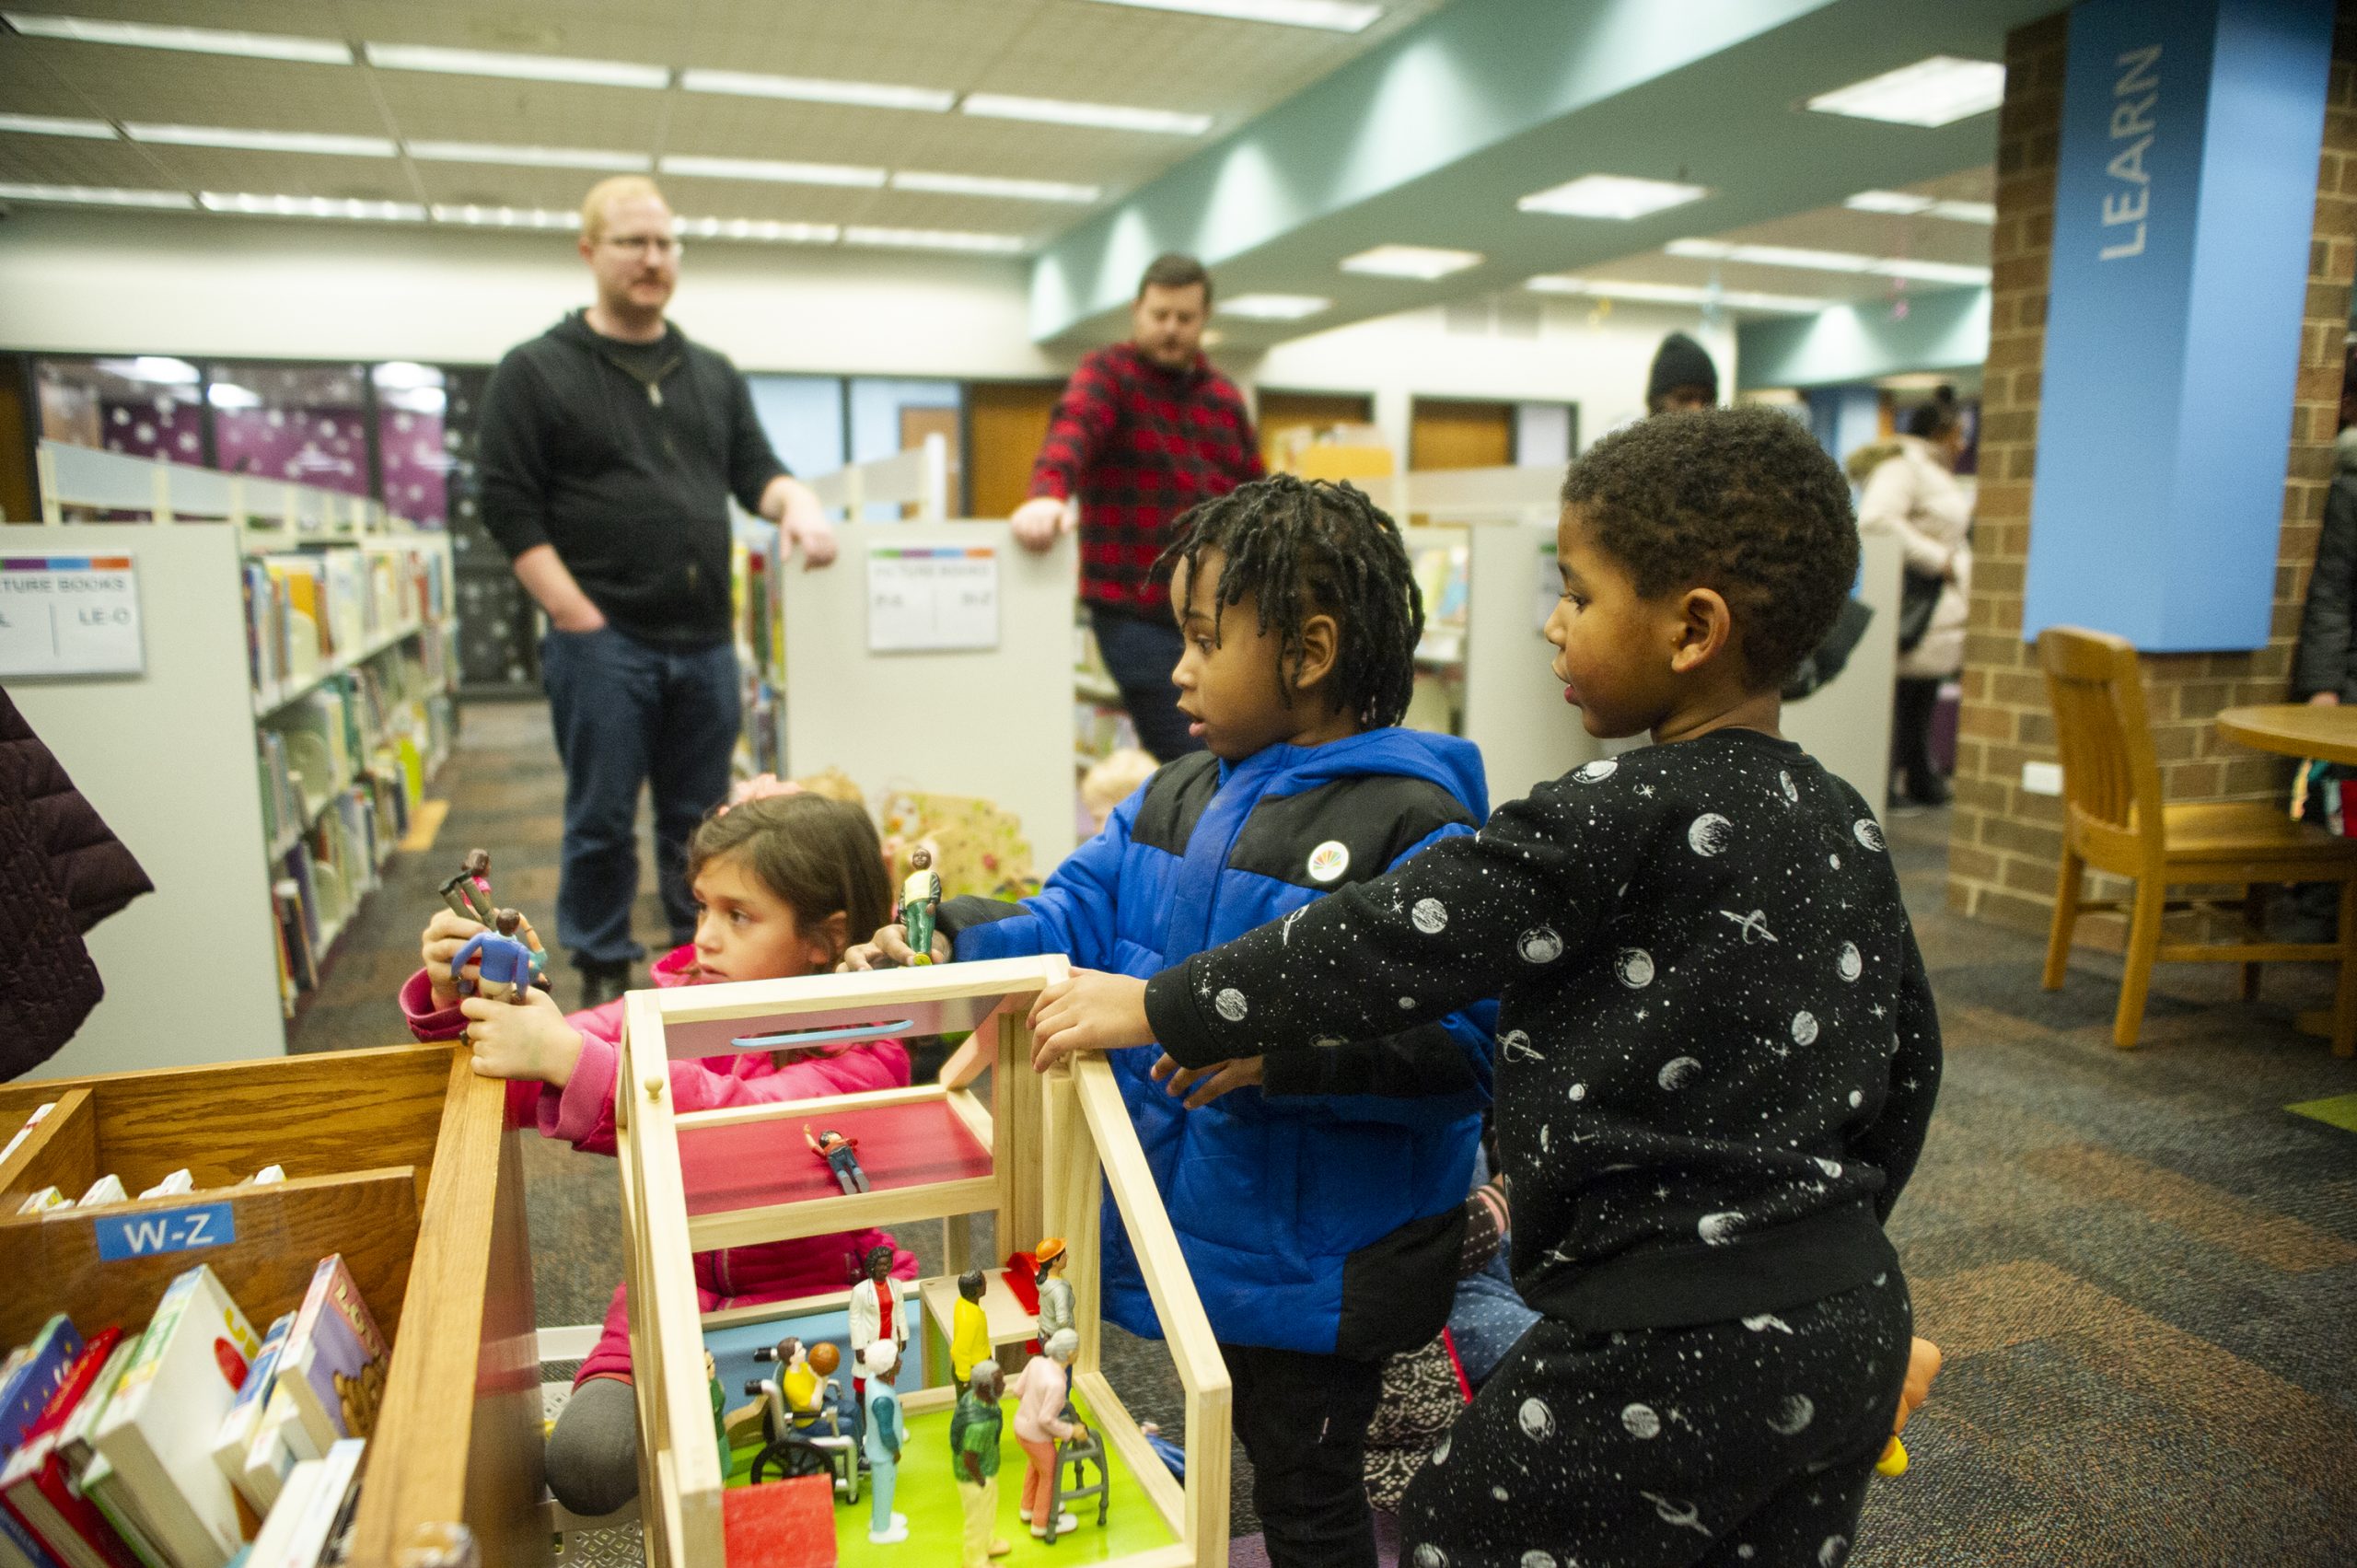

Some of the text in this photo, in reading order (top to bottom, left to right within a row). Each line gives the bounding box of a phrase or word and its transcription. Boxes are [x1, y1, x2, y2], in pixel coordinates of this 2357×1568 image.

[2099, 45, 2162, 261] LEARN
[57, 577, 127, 593] BOOKS
[123, 1214, 215, 1253] W-Z
